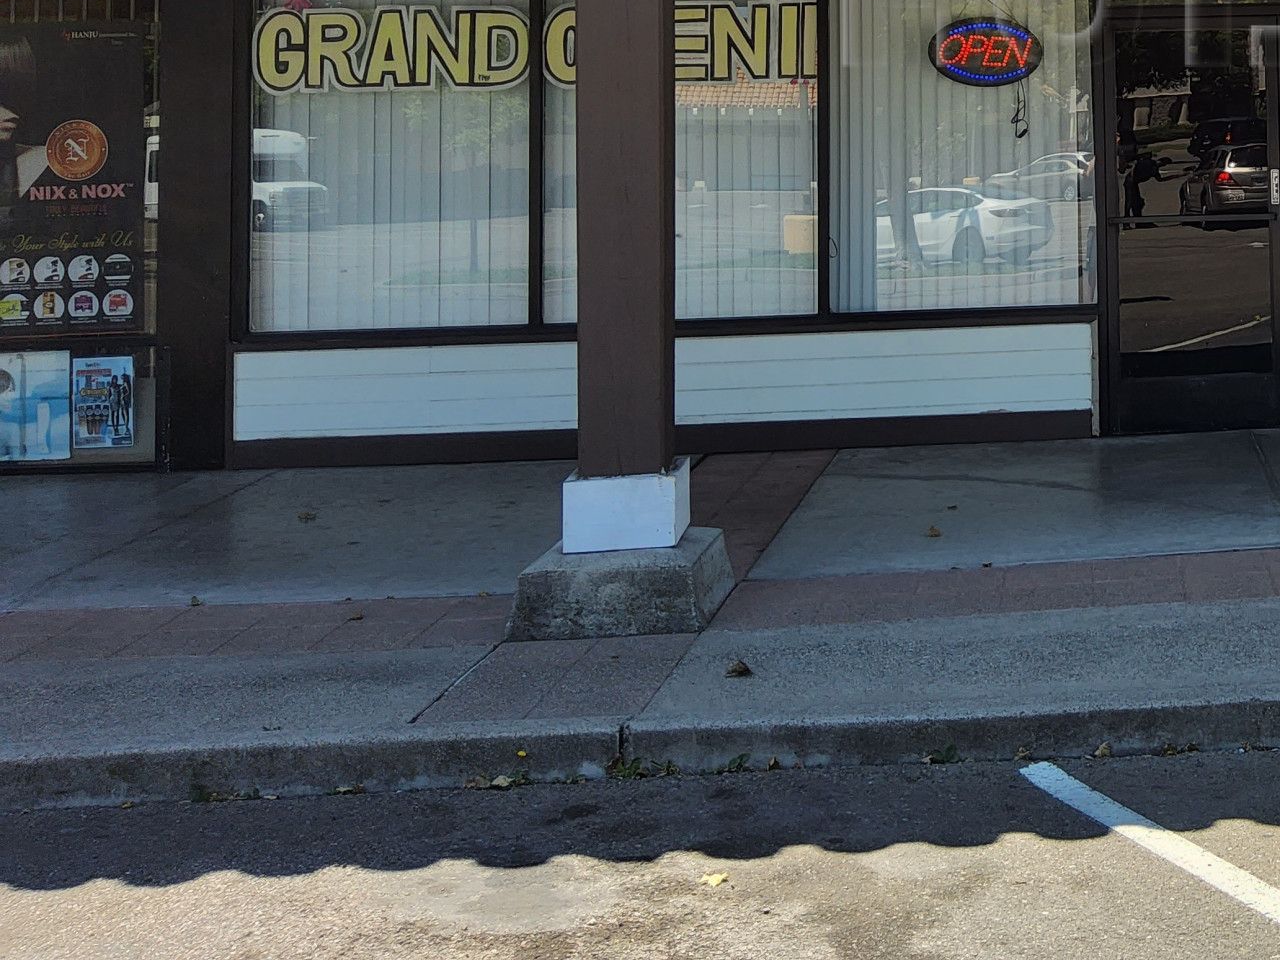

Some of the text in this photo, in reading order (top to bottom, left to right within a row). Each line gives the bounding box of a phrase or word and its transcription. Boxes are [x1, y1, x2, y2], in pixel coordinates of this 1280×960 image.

[253, 0, 817, 94] GRAND OENI
[939, 34, 1032, 67] OPEN
[30, 185, 66, 200] NIX
[68, 188, 78, 199] &
